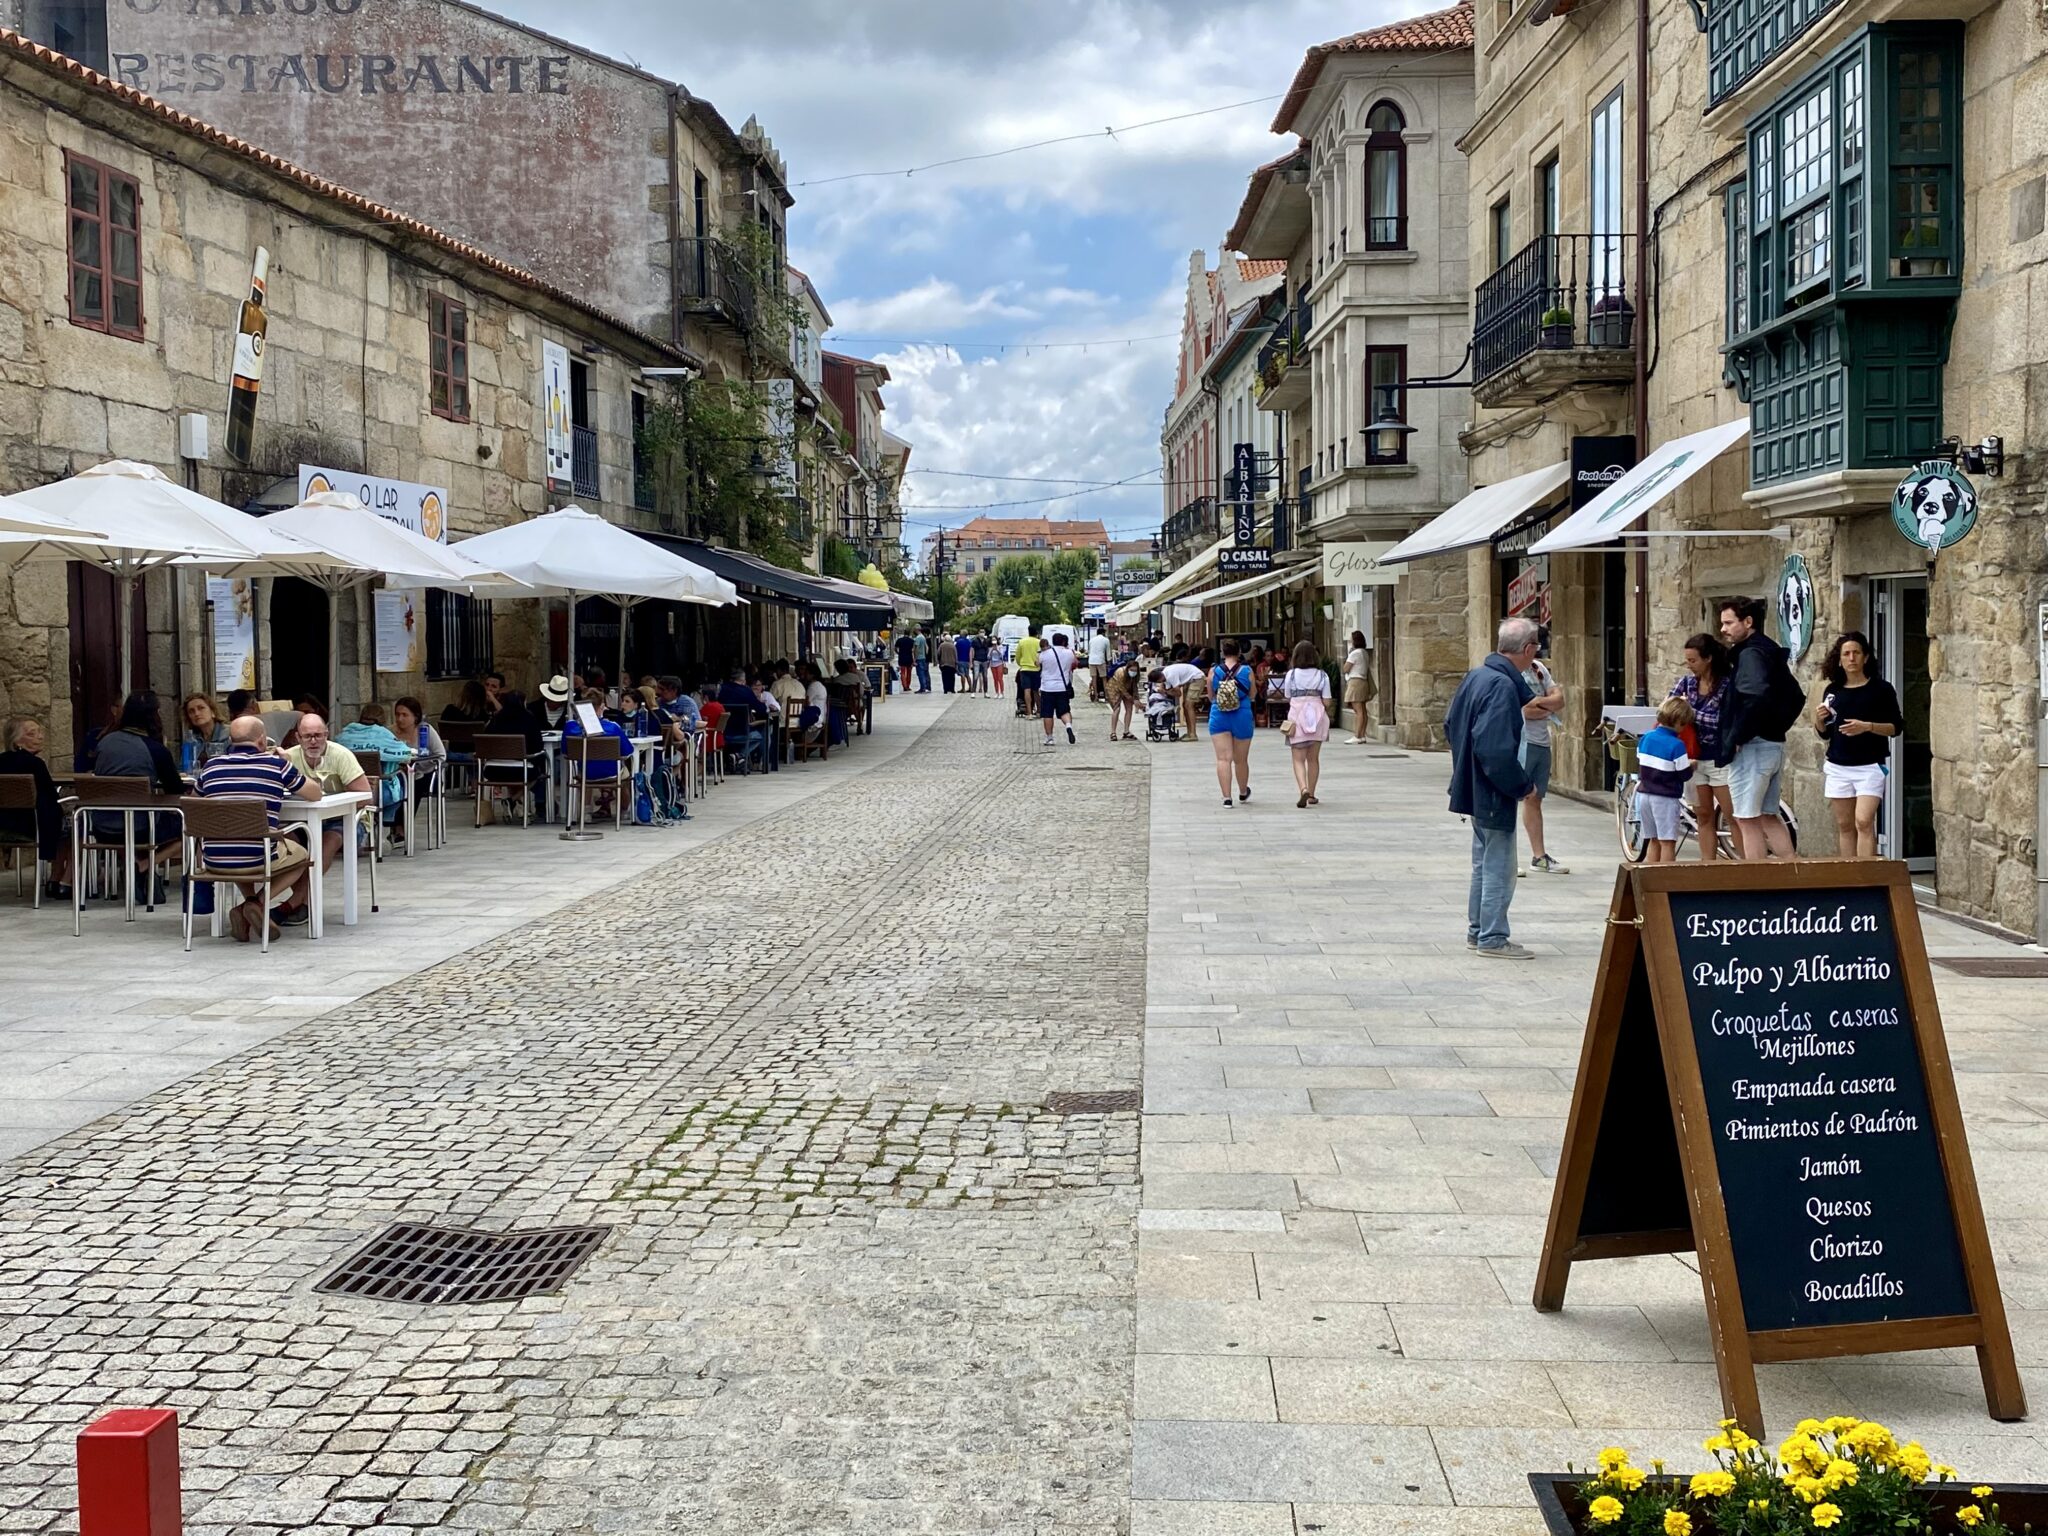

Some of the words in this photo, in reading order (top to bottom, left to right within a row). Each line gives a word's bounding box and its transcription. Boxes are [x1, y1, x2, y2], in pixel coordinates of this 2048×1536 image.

[112, 53, 570, 95] RESTAURANTE
[1577, 470, 1599, 481] Foot
[1599, 471, 1612, 481] on
[1920, 461, 1955, 477] TONY'S
[359, 483, 371, 506] O
[375, 485, 398, 511] LAR
[1238, 447, 1250, 540] ALBARIÑO
[1220, 551, 1229, 562] O
[1232, 550, 1269, 562] CASAL
[1123, 573, 1130, 581] O
[1686, 905, 1846, 945] Especialidad
[1850, 913, 1879, 933] en
[1692, 957, 1763, 994] Pulpo
[1769, 965, 1784, 993] y
[1788, 954, 1891, 987] Albariño
[1711, 1001, 1812, 1049] Croquetas
[1829, 1007, 1899, 1028] caseras
[1759, 1033, 1856, 1065] Mejillones
[1731, 1072, 1836, 1106] Empanada
[1840, 1076, 1897, 1095] casera
[1725, 1117, 1820, 1141] Pimientos
[1825, 1111, 1846, 1136] de
[1850, 1109, 1919, 1134] Padrón
[1799, 1153, 1863, 1182] Jamón
[1805, 1196, 1872, 1226] Quesos
[1809, 1234, 1884, 1262] Chorizo
[1804, 1272, 1904, 1303] Bocadillos
